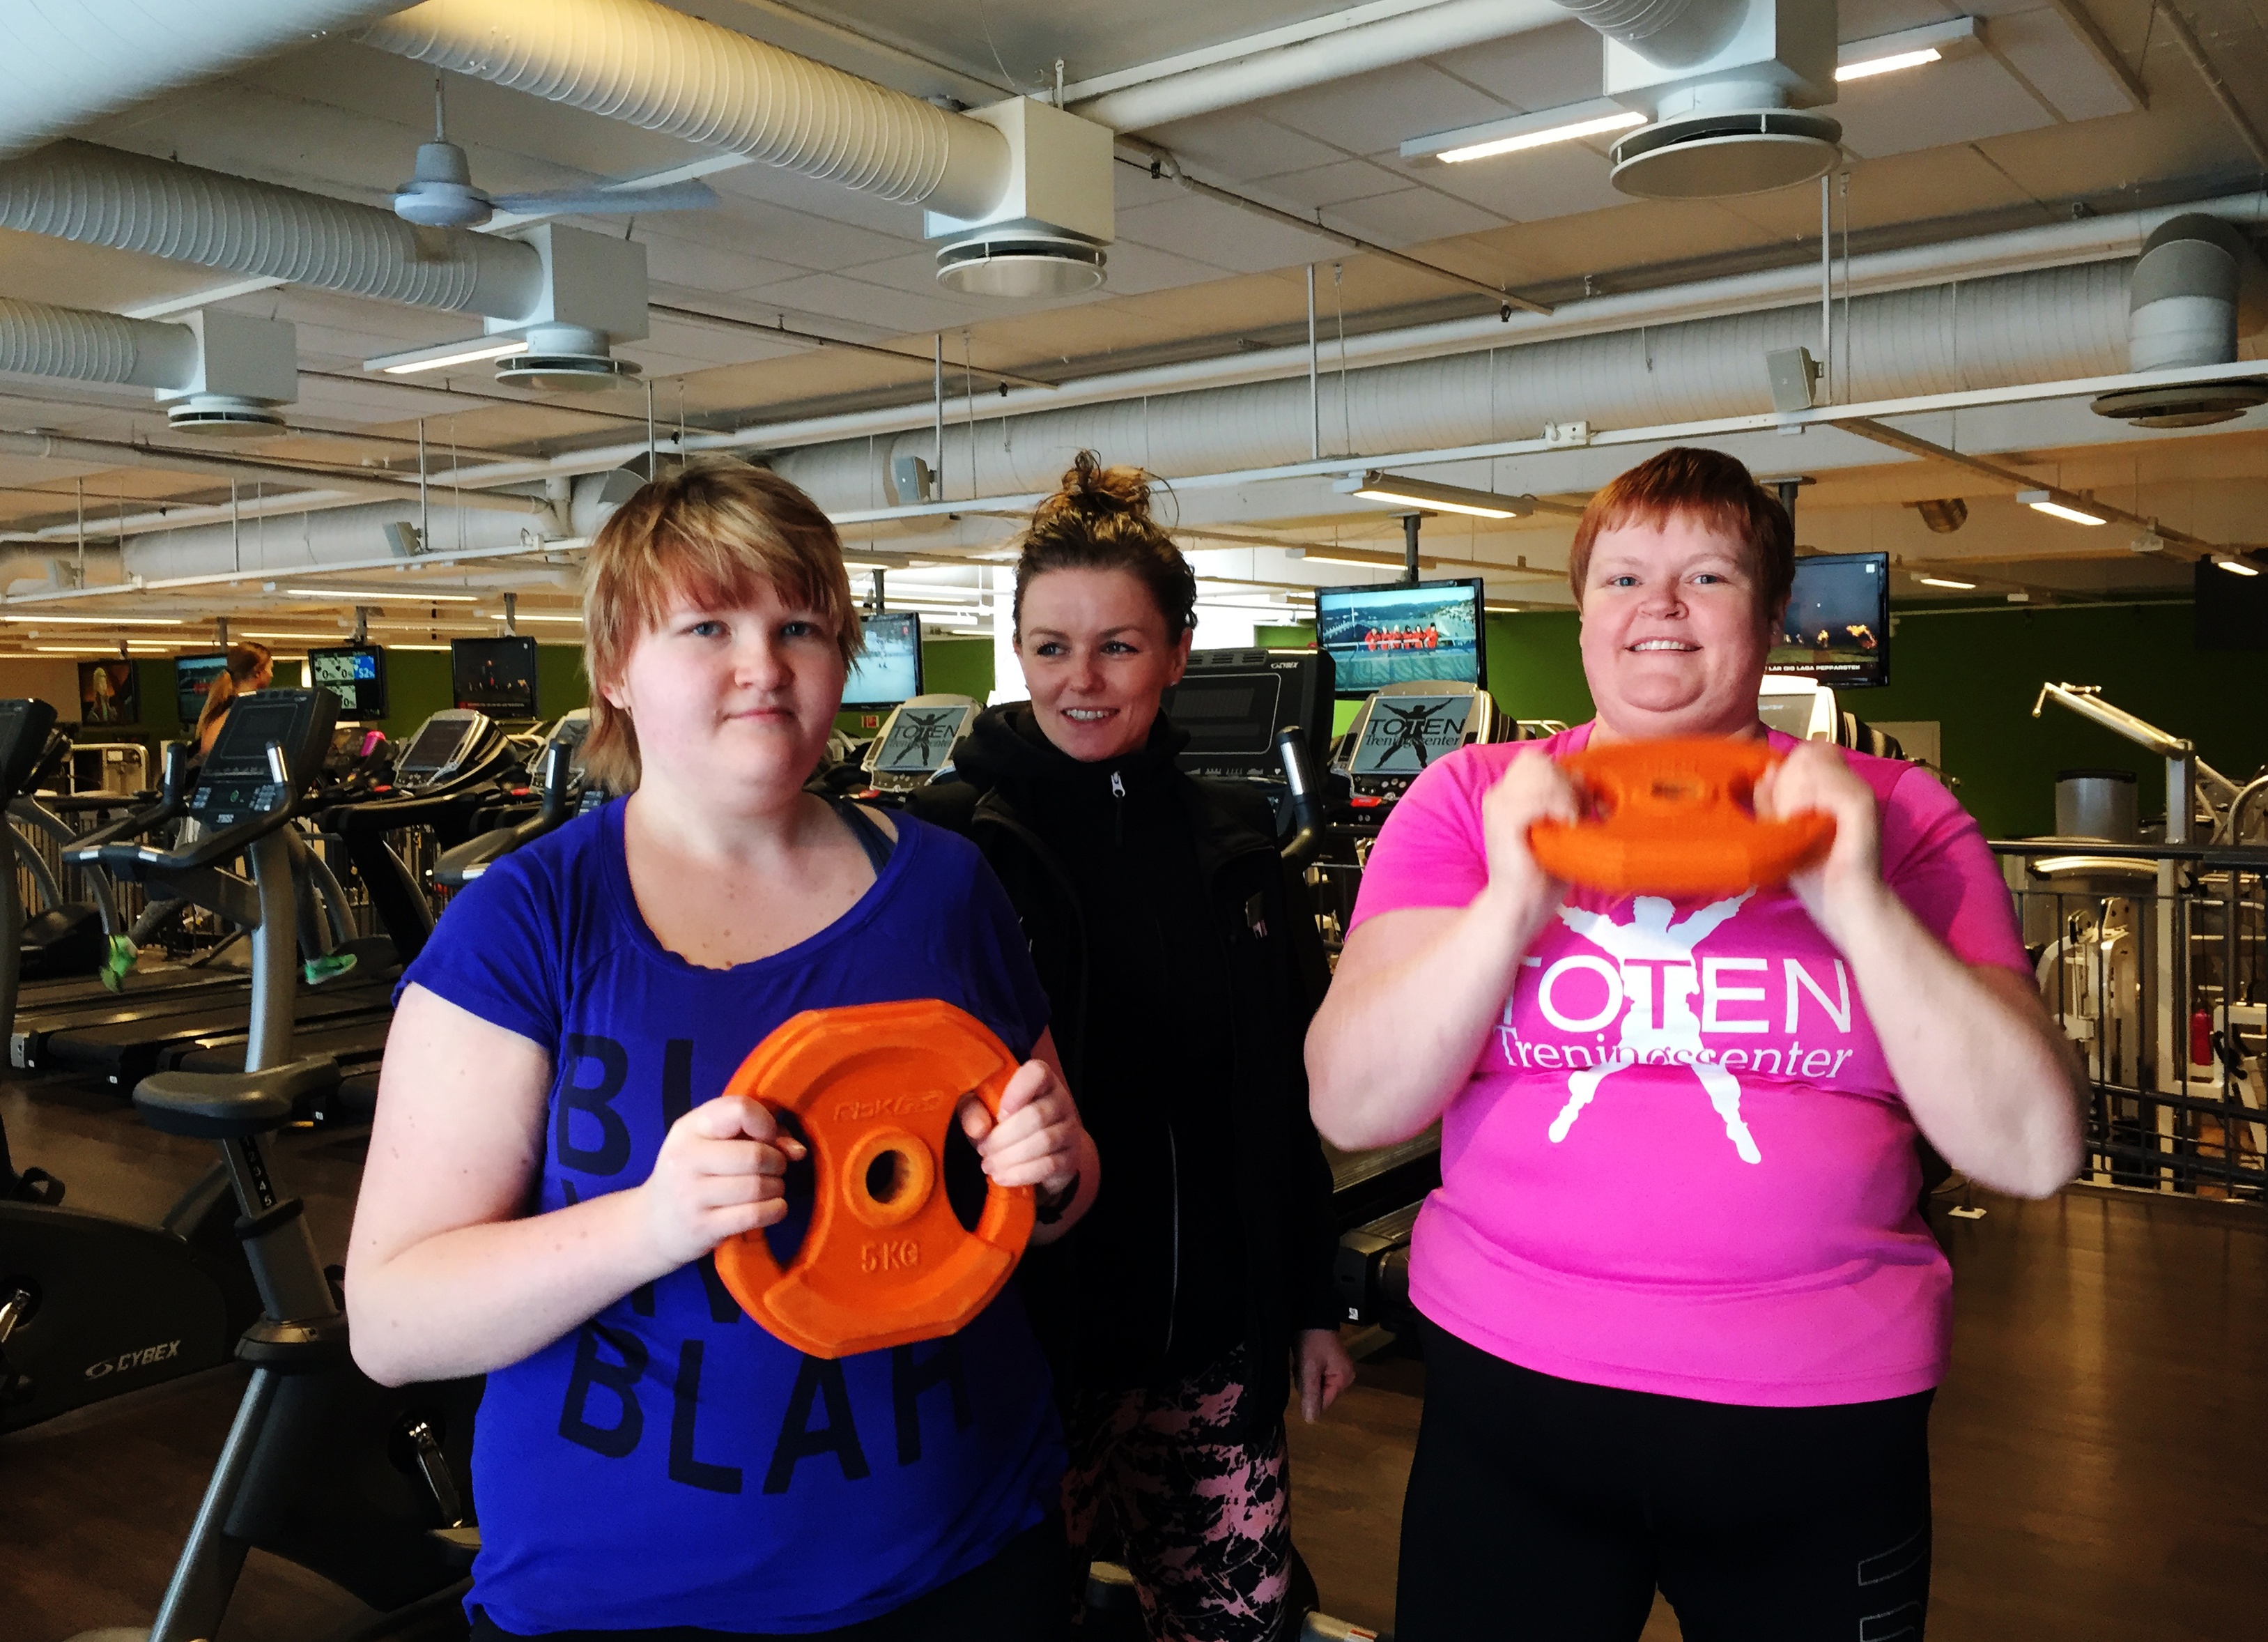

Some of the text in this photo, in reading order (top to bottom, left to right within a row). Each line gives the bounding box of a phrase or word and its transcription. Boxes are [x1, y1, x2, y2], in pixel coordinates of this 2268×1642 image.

[894, 724, 956, 739] TOTEN
[1368, 719, 1467, 735] TOTEN
[264, 1195, 272, 1207] 5
[116, 1340, 181, 1372] CYBEX
[558, 1326, 973, 1496] BLAH
